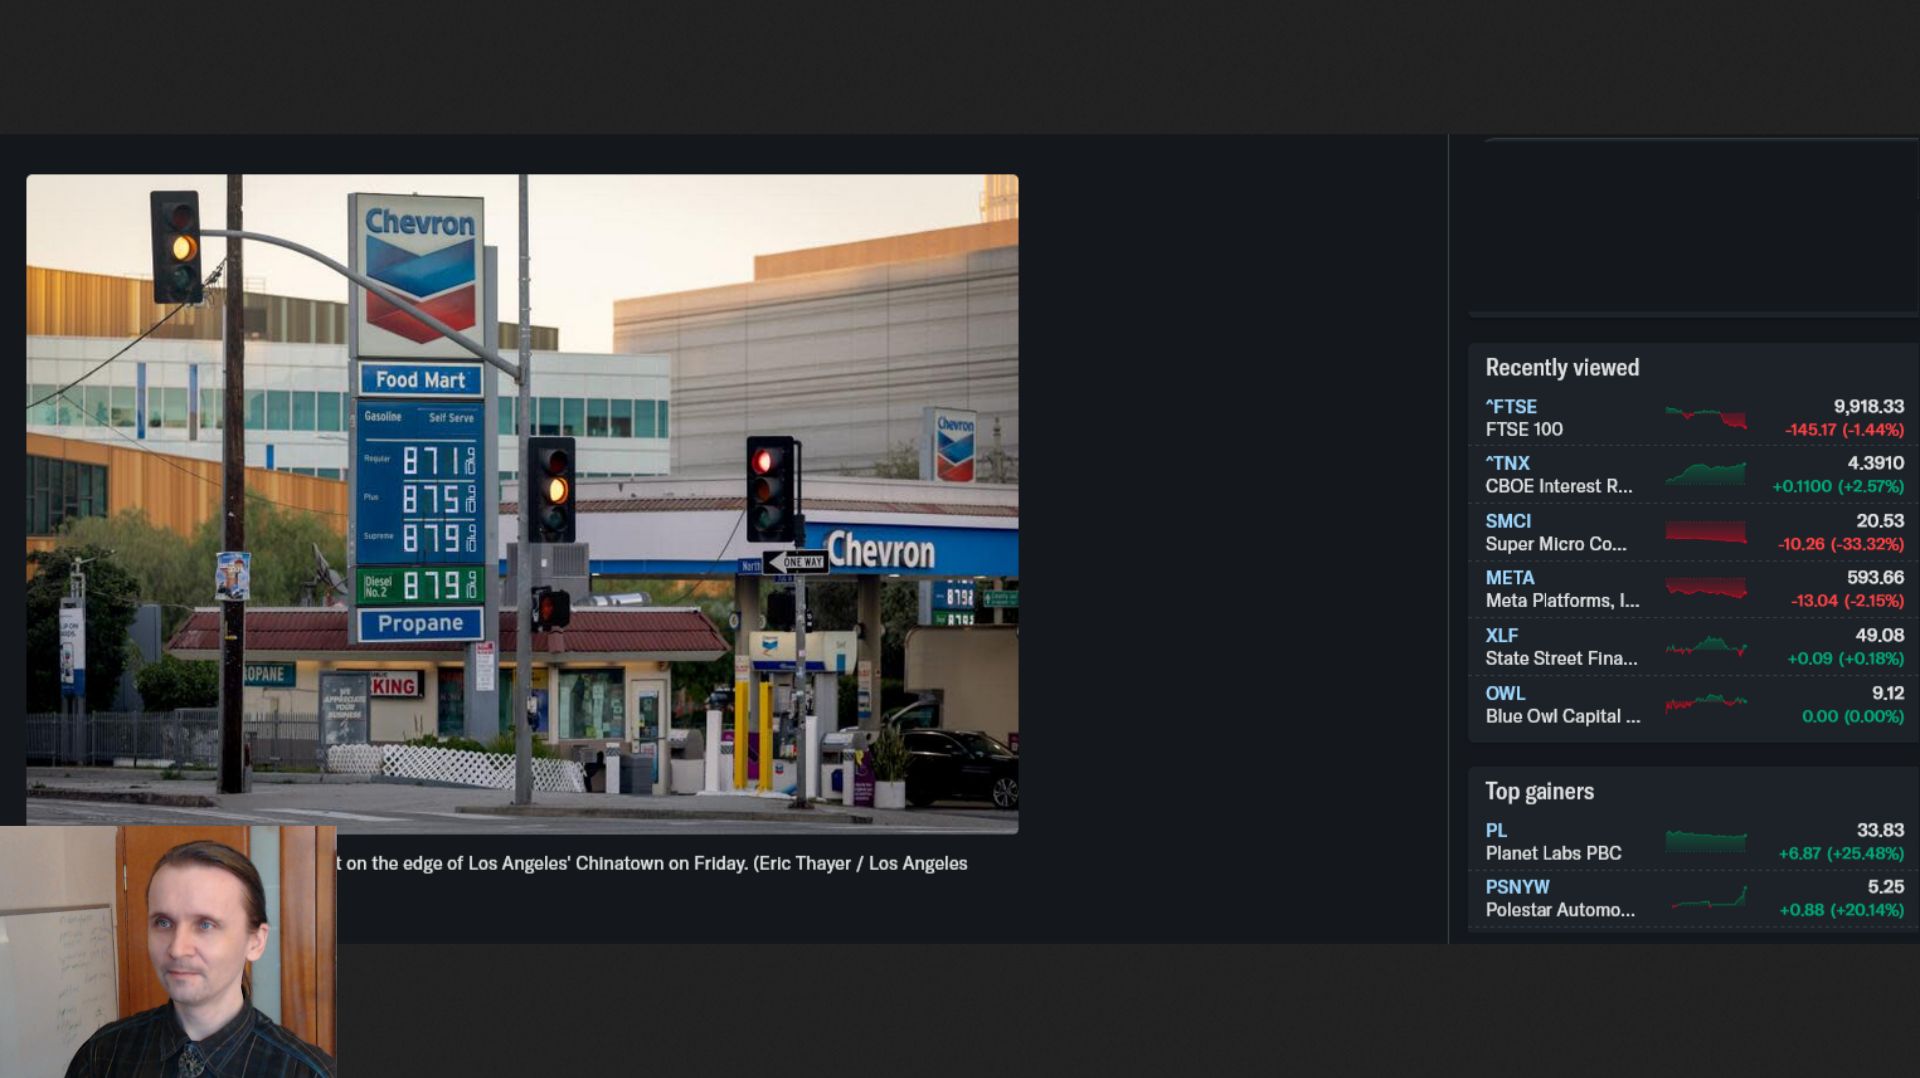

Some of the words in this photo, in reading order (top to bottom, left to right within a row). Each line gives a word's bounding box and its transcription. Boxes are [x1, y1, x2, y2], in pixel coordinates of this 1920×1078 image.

[366, 207, 475, 236] Chevron
[1486, 357, 1568, 381] Recently
[1573, 357, 1640, 377] viewed
[377, 371, 418, 388] Food
[425, 371, 466, 388] Mart
[1486, 399, 1537, 414] ^FTSE
[1834, 399, 1905, 417] 9,918.33
[364, 411, 402, 422] Gasoline
[429, 413, 446, 423] Self
[448, 413, 475, 423] Serve
[1487, 422, 1529, 436] FTSE
[1533, 422, 1563, 436] 100
[1785, 422, 1837, 436] -145.17
[1843, 422, 1905, 439] (-1.44%)
[403, 446, 459, 475] 871
[1486, 455, 1530, 470] ^TNX
[1848, 455, 1905, 470] 4.3910
[1486, 478, 1534, 493] CBOE
[1540, 478, 1602, 493] Interest
[1773, 479, 1832, 494] +0.1100
[1838, 479, 1905, 496] (+2.57%)
[403, 485, 459, 513] 875
[1486, 513, 1531, 528] SMCI
[1857, 513, 1905, 528] 20.53
[363, 532, 394, 541] Supreme
[403, 524, 459, 552] 879
[1486, 536, 1535, 554] Super
[1539, 536, 1585, 551] Micro
[1778, 537, 1825, 551] -10.26
[1831, 537, 1905, 554] (-33.32%)
[828, 529, 935, 568] Chevron
[784, 557, 802, 567] ONE
[804, 557, 822, 567] WAY
[364, 576, 392, 586] Diesel
[404, 571, 459, 599] 879
[1486, 570, 1535, 585] META
[1848, 570, 1905, 585] 593.66
[1487, 593, 1527, 607] Meta
[1533, 593, 1614, 610] Platforms,
[1792, 594, 1839, 608] -13.04
[1844, 594, 1905, 611] (-2.15%)
[379, 615, 463, 635] Propane
[1486, 628, 1519, 643] XLF
[1856, 628, 1905, 643] 49.08
[1486, 650, 1529, 665] State
[1533, 650, 1583, 665] Street
[1589, 650, 1638, 665] Fina...
[1788, 651, 1833, 665] +0.09
[1839, 651, 1905, 668] (+0.18%)
[373, 679, 415, 694] KING
[1486, 686, 1526, 701] OWL
[1872, 686, 1905, 701] 9.12
[1487, 708, 1523, 723] Blue
[1527, 708, 1558, 723] Owl
[1562, 708, 1621, 727] Capital
[1803, 709, 1838, 723] 0.00
[1844, 709, 1905, 726] (0.00%)
[1485, 781, 1520, 805] Top
[1526, 781, 1594, 805] gainers
[1486, 822, 1508, 838] PL
[1857, 822, 1905, 838] 33.83
[1487, 845, 1539, 860] Planet
[1543, 845, 1581, 860] Labs
[1587, 845, 1622, 860] PBC
[1780, 846, 1821, 860] +6.87
[1827, 846, 1905, 863] (+25.48%)
[346, 859, 367, 871] on
[371, 855, 398, 871] the
[403, 855, 442, 875] edge
[447, 855, 464, 871] of
[469, 855, 498, 871] Los
[502, 855, 572, 875] Angeles'
[576, 855, 664, 871] Chinatown
[668, 859, 689, 871] on
[694, 855, 748, 875] Friday.
[754, 855, 791, 874] (Eric
[795, 855, 852, 875] Thayer
[856, 855, 865, 873] /
[870, 855, 898, 871] Los
[902, 855, 968, 875] Angeles
[1486, 879, 1550, 894] PSNYW
[1868, 879, 1905, 894] 5.25
[1487, 902, 1553, 918] Polestar
[1556, 902, 1636, 918] Automo...
[1780, 903, 1824, 917] +0.88
[1831, 903, 1905, 920] (+20.14%)
